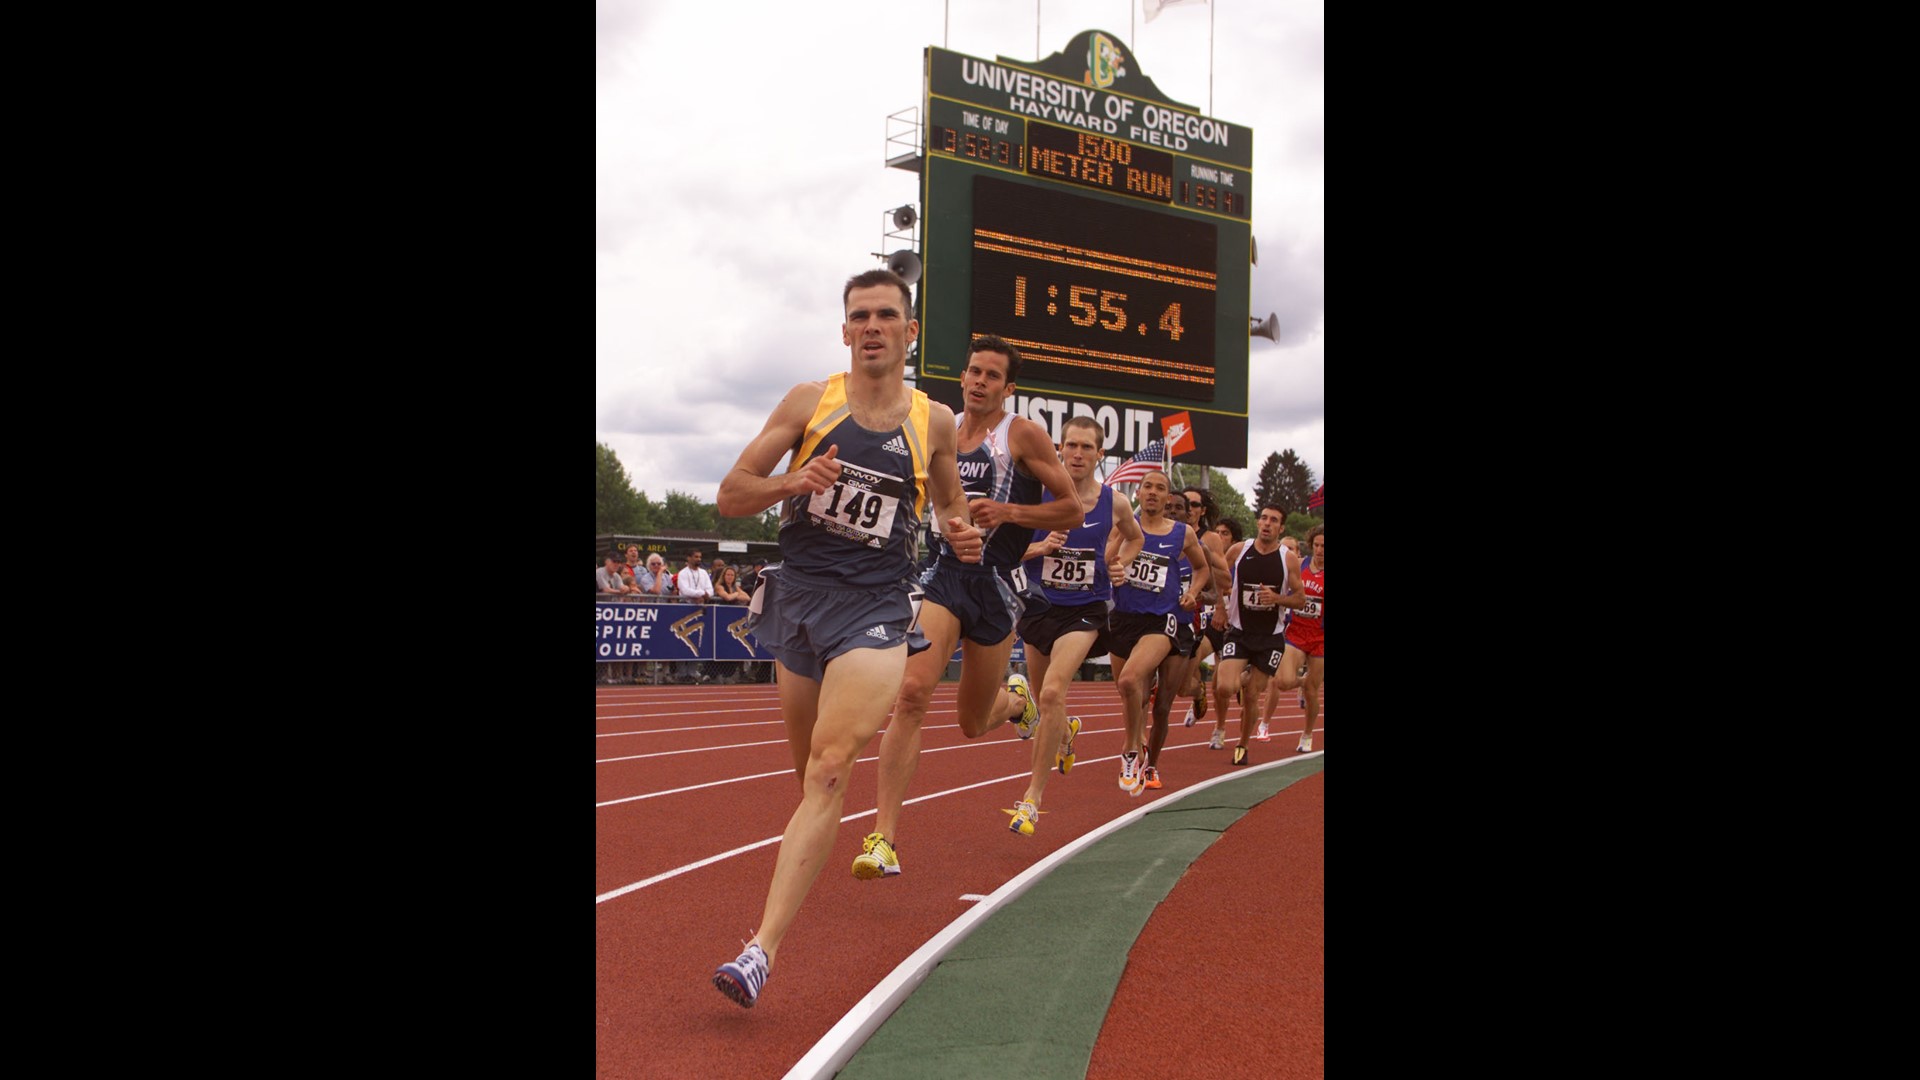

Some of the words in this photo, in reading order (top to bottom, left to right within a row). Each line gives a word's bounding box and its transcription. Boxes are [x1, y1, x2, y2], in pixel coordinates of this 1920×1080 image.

[962, 58, 1094, 112] UNIVERSITY
[1104, 95, 1134, 122] OF
[1142, 105, 1228, 146] OREGON
[962, 111, 980, 128] TIME
[982, 115, 993, 131] OF
[995, 119, 1009, 135] DAY
[1010, 96, 1117, 134] HAYWARD
[1130, 125, 1188, 151] FIELD
[1078, 133, 1131, 165] 1500
[1031, 145, 1112, 186] METER
[1127, 167, 1172, 198] RUN
[1191, 164, 1218, 183] RUNNING
[1220, 170, 1234, 187] TIME
[1015, 275, 1184, 341] 1:55.4
[1002, 394, 1067, 445] UST
[881, 444, 909, 456] adidas
[843, 467, 882, 484] ENVOY
[847, 479, 872, 492] GMC
[825, 484, 882, 529] 149
[647, 544, 667, 552] AREA
[1014, 568, 1024, 590] 1
[1051, 559, 1086, 582] 285
[1130, 560, 1160, 583] 505
[1302, 579, 1323, 594] ANSAS
[596, 607, 658, 622] GOLDEN
[1300, 602, 1316, 614] 69
[1167, 615, 1175, 635] 9
[597, 643, 642, 656] OUR
[1224, 643, 1234, 655] 8
[1271, 652, 1280, 666] 8
